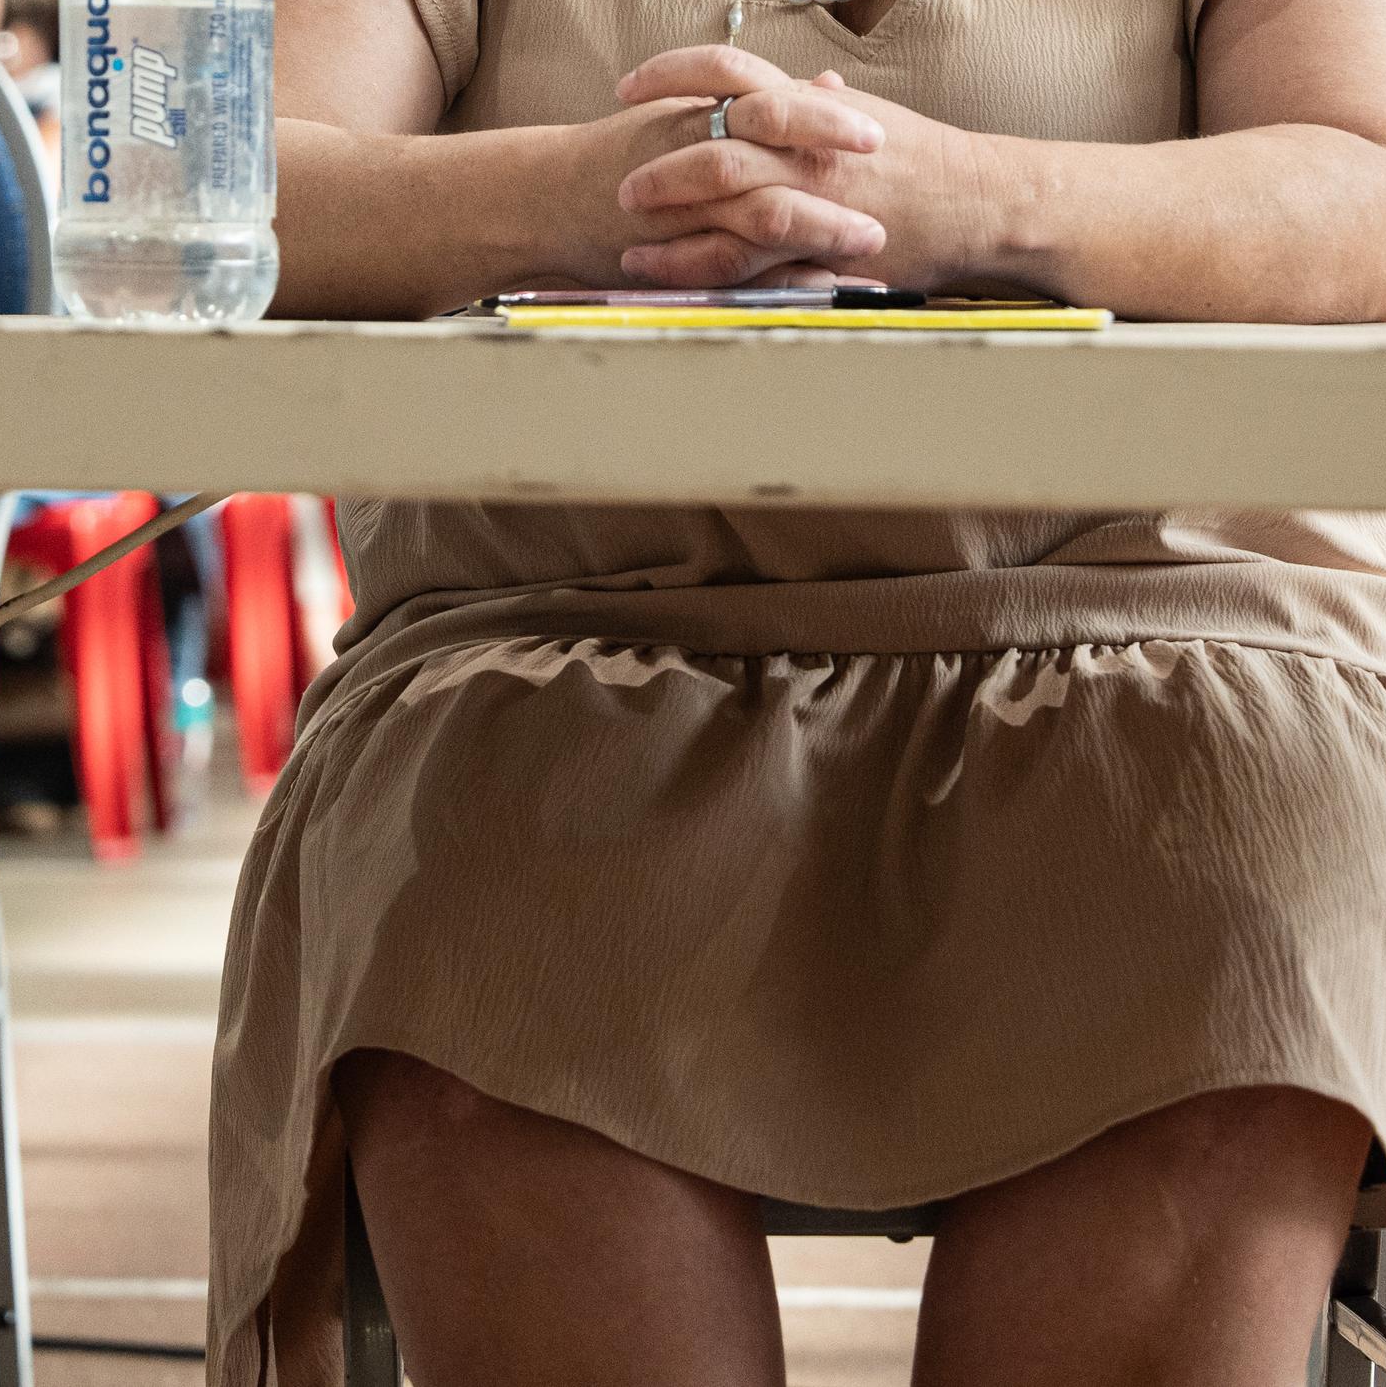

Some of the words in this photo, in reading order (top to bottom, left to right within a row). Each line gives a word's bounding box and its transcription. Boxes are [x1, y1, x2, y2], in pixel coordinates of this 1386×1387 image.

[210, 14, 227, 39] 750
[130, 44, 179, 149] pump
[212, 71, 230, 116] WATER
[169, 108, 187, 137] still
[212, 121, 229, 190] PREPARED
